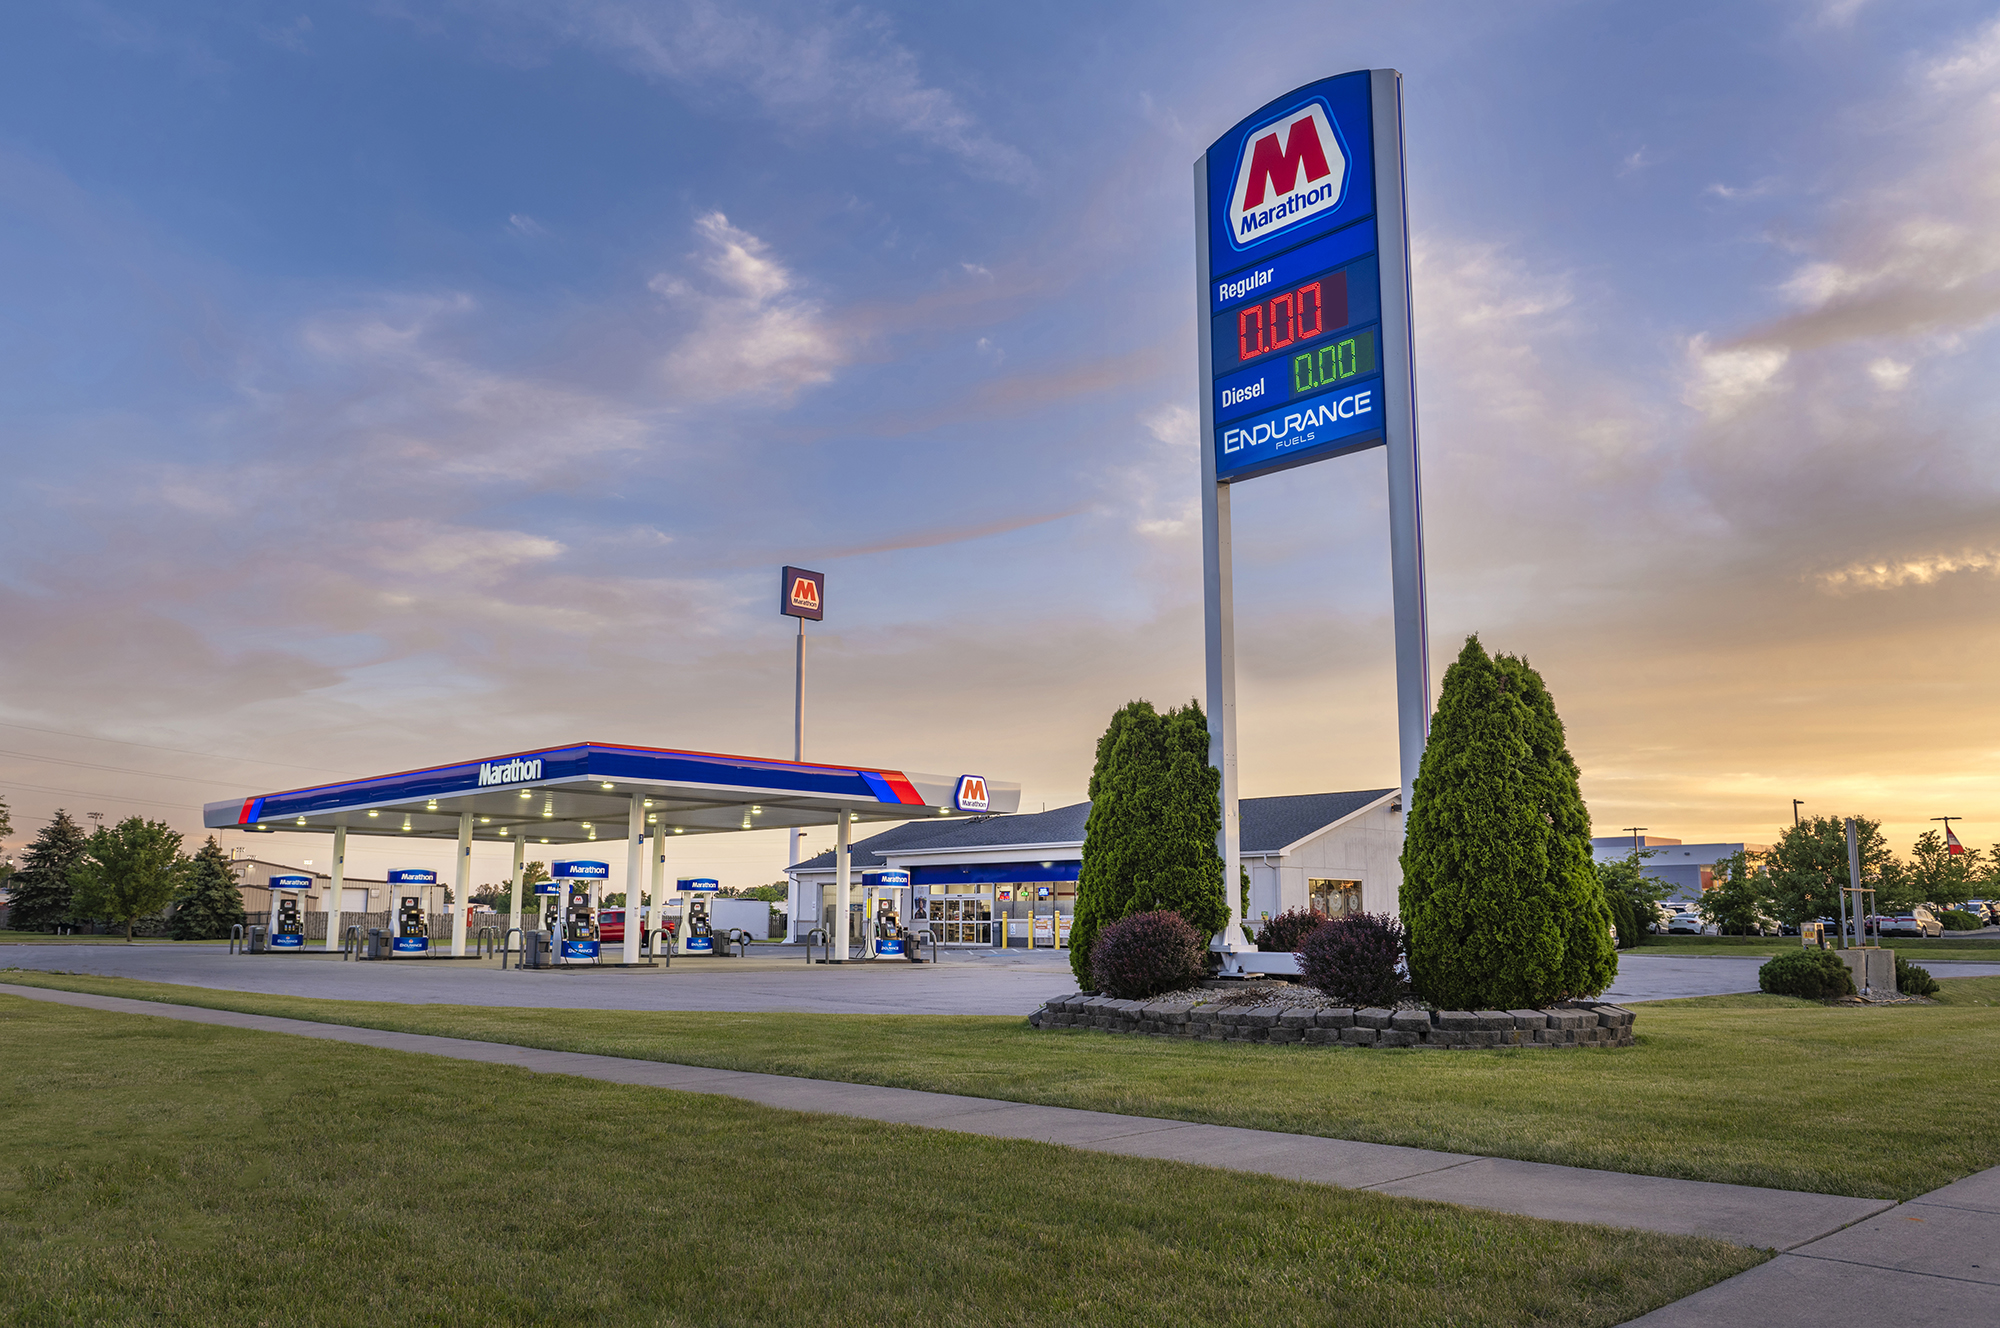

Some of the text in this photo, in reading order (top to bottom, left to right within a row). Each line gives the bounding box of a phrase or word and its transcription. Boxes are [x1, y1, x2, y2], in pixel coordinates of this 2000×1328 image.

[1243, 115, 1331, 212] M
[1240, 183, 1332, 236] Marathon
[1219, 267, 1274, 302] Regular
[1240, 281, 1323, 361] 0.00
[1294, 338, 1357, 393] 0.00
[1222, 377, 1265, 408] Diesel
[1224, 390, 1372, 455] ENDURANCE
[1275, 431, 1315, 450] FUELS
[792, 598, 818, 608] Marathon
[794, 580, 816, 601] M
[478, 758, 542, 786] Marathon
[963, 779, 985, 801] M
[961, 799, 987, 808] Marathon
[401, 872, 434, 881] Marathon
[570, 865, 606, 874] Marathon
[881, 875, 908, 883] Marathon
